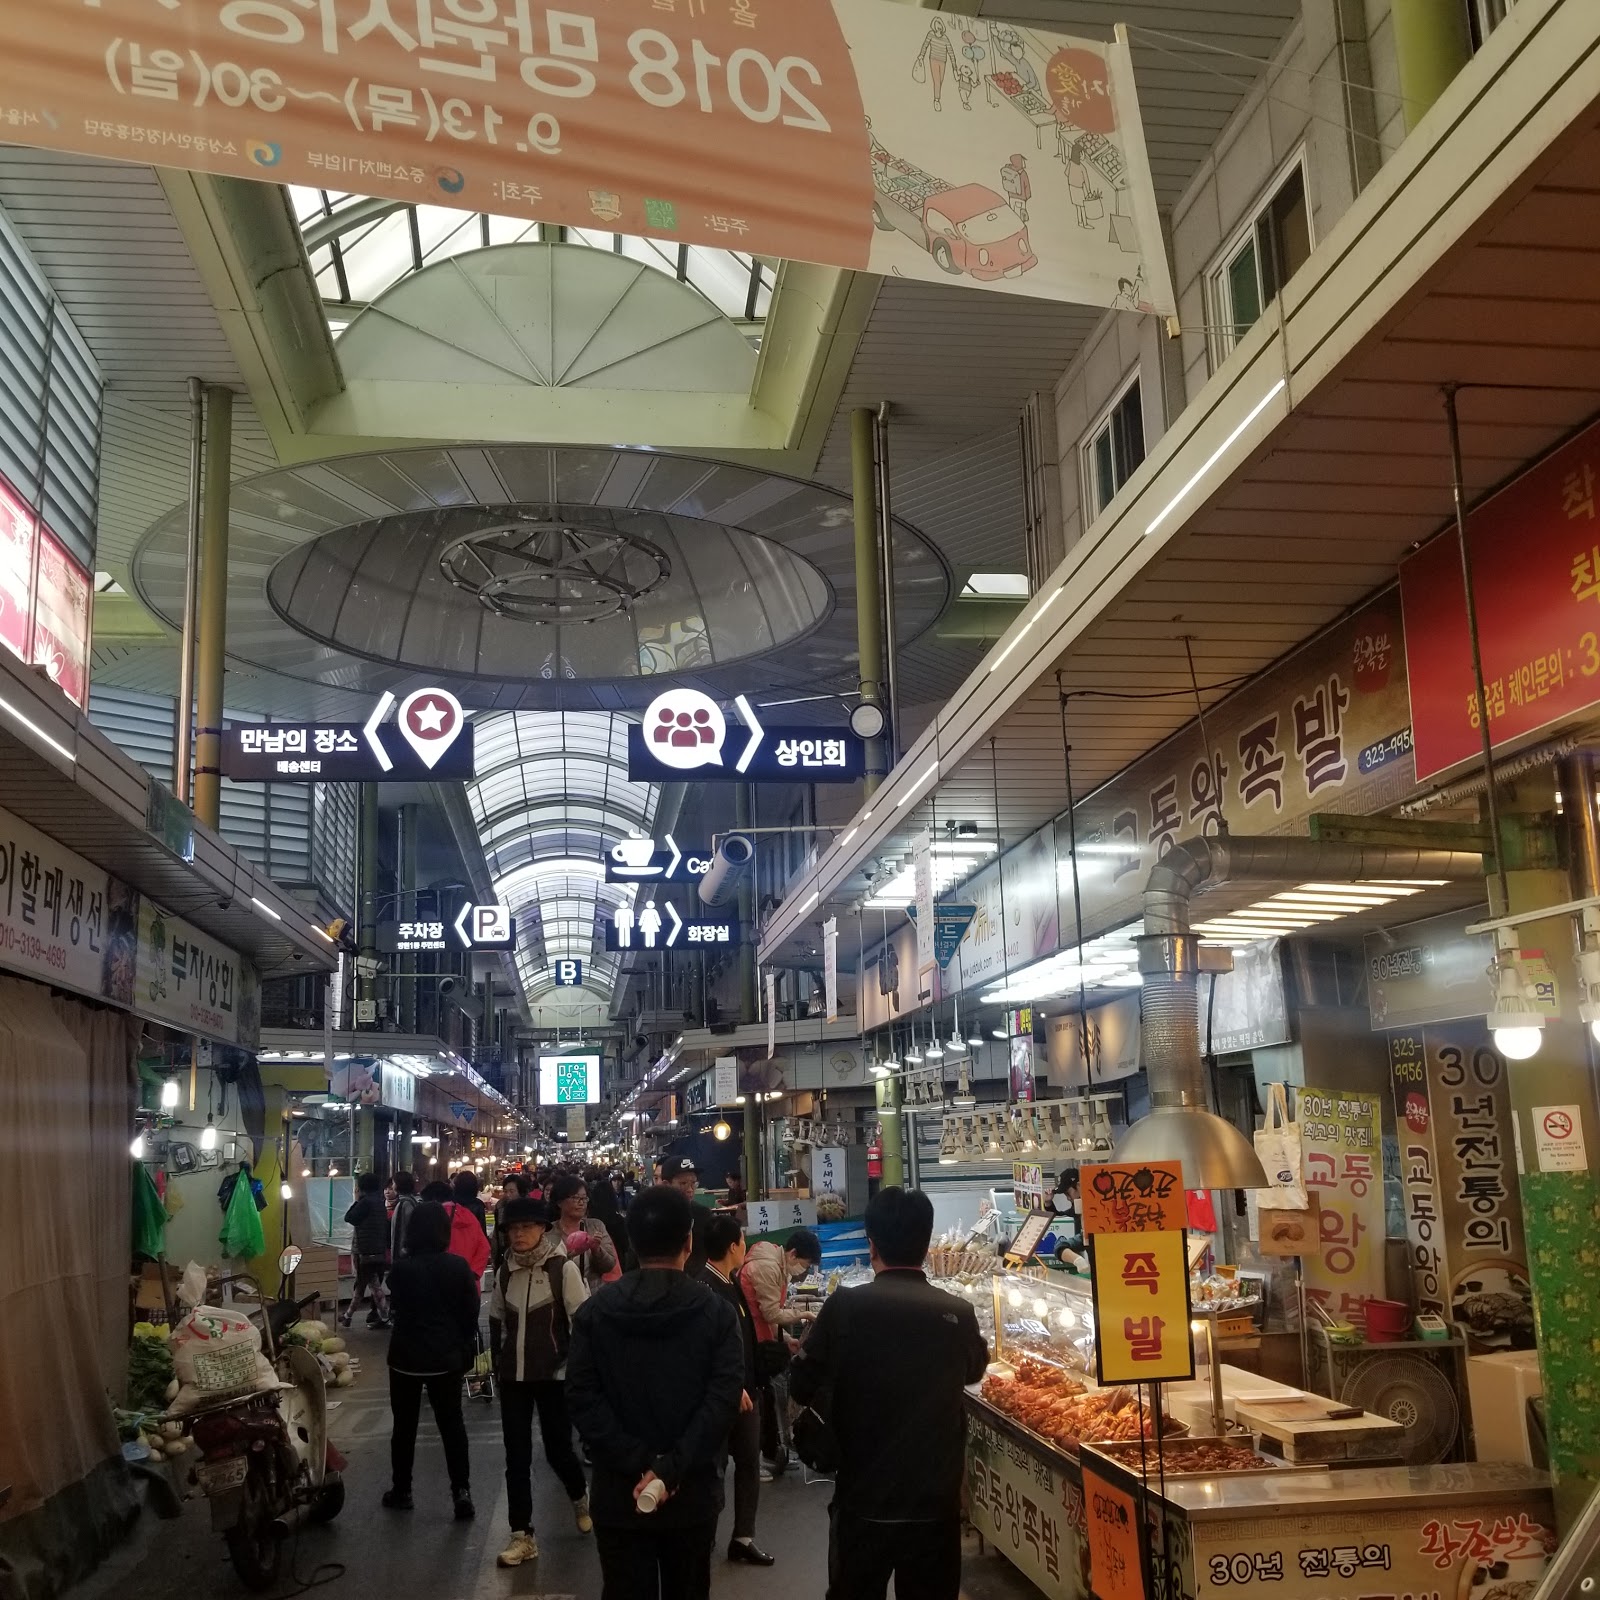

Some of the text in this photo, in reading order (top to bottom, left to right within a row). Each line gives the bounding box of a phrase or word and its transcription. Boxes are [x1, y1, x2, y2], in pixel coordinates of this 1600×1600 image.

[240, 729, 358, 754] 만남의 장소
[774, 739, 846, 767] 상인회
[277, 760, 321, 774] 배송센터
[398, 922, 444, 940] 주차장
[687, 925, 730, 943] 화장실
[171, 935, 233, 1012] 부자상회
[560, 960, 577, 980] B
[1395, 1060, 1423, 1084] 9956
[1303, 1096, 1374, 1121] 30년 전통의
[1303, 1124, 1340, 1144] 최고의
[974, 1456, 1061, 1584] 교동왕족발
[1419, 1512, 1547, 1570] 왕족발
[1209, 1543, 1392, 1587] 30년 전통의
